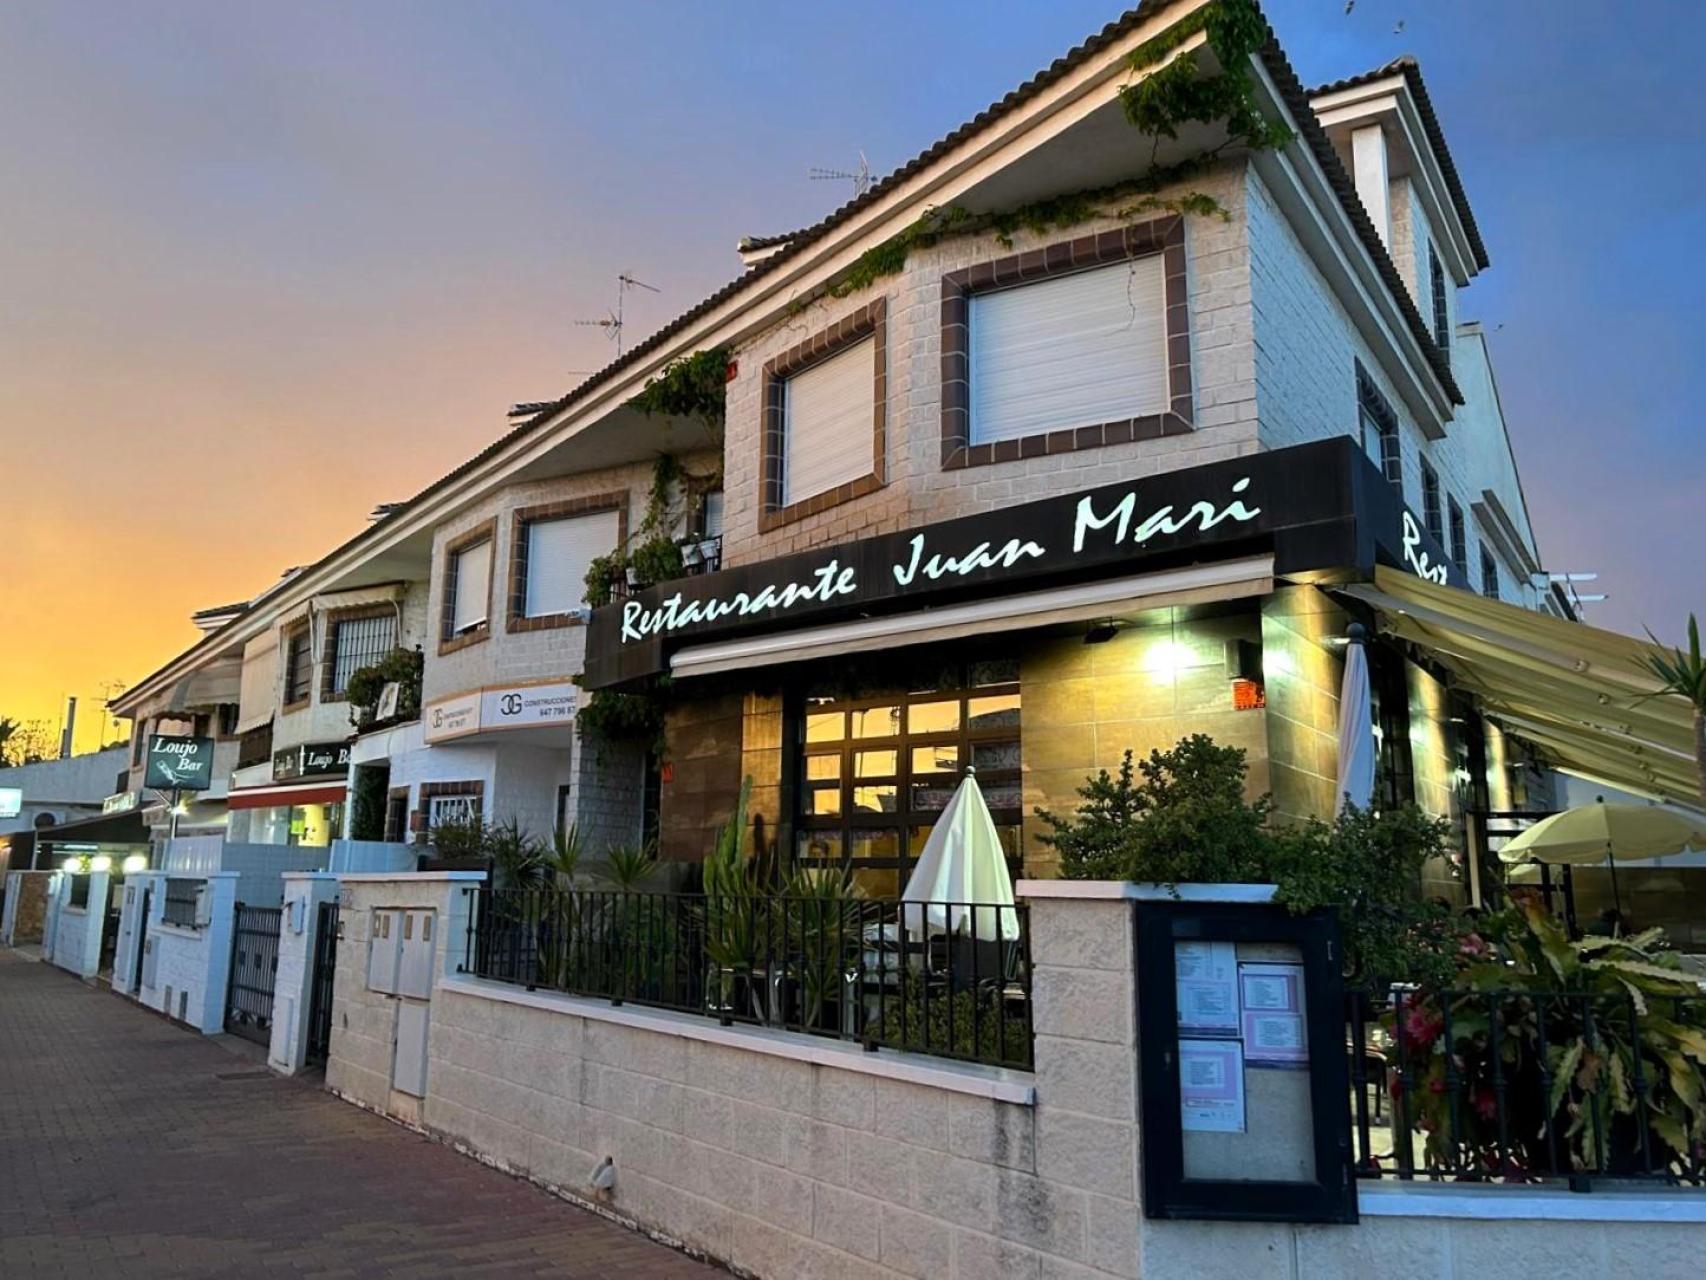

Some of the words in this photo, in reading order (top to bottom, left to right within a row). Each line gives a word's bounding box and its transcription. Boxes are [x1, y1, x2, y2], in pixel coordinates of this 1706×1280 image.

[621, 559, 858, 644] Restaurante
[893, 533, 1046, 586] Juan
[1072, 477, 1262, 553] Mari
[152, 737, 198, 759] Loujo
[176, 757, 203, 772] Bar
[307, 752, 334, 769] Loujo
